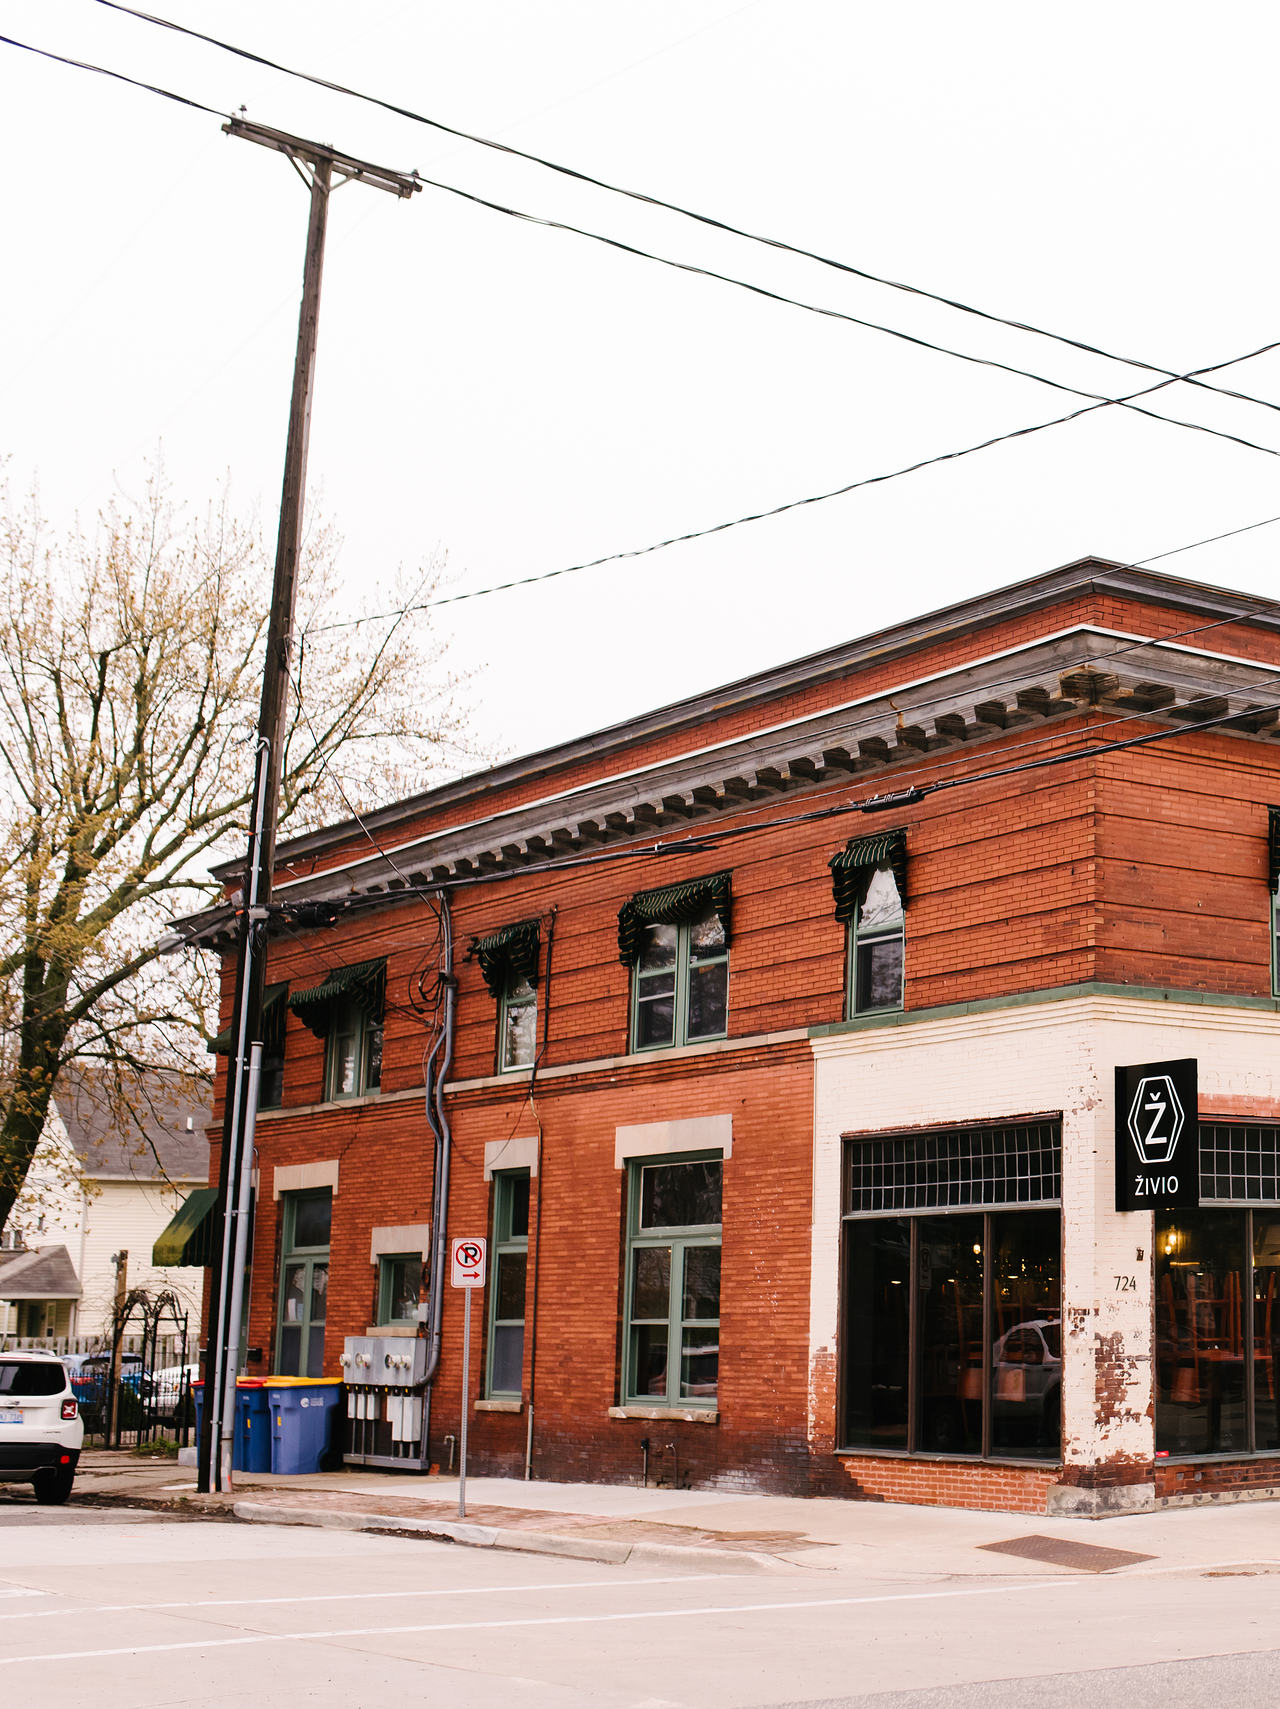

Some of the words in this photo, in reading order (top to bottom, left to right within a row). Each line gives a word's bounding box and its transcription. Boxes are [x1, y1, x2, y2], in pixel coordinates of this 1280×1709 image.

[1144, 1091, 1168, 1145] Ž
[1134, 1174, 1179, 1197] ŽIVIO
[1113, 1275, 1137, 1291] 724
